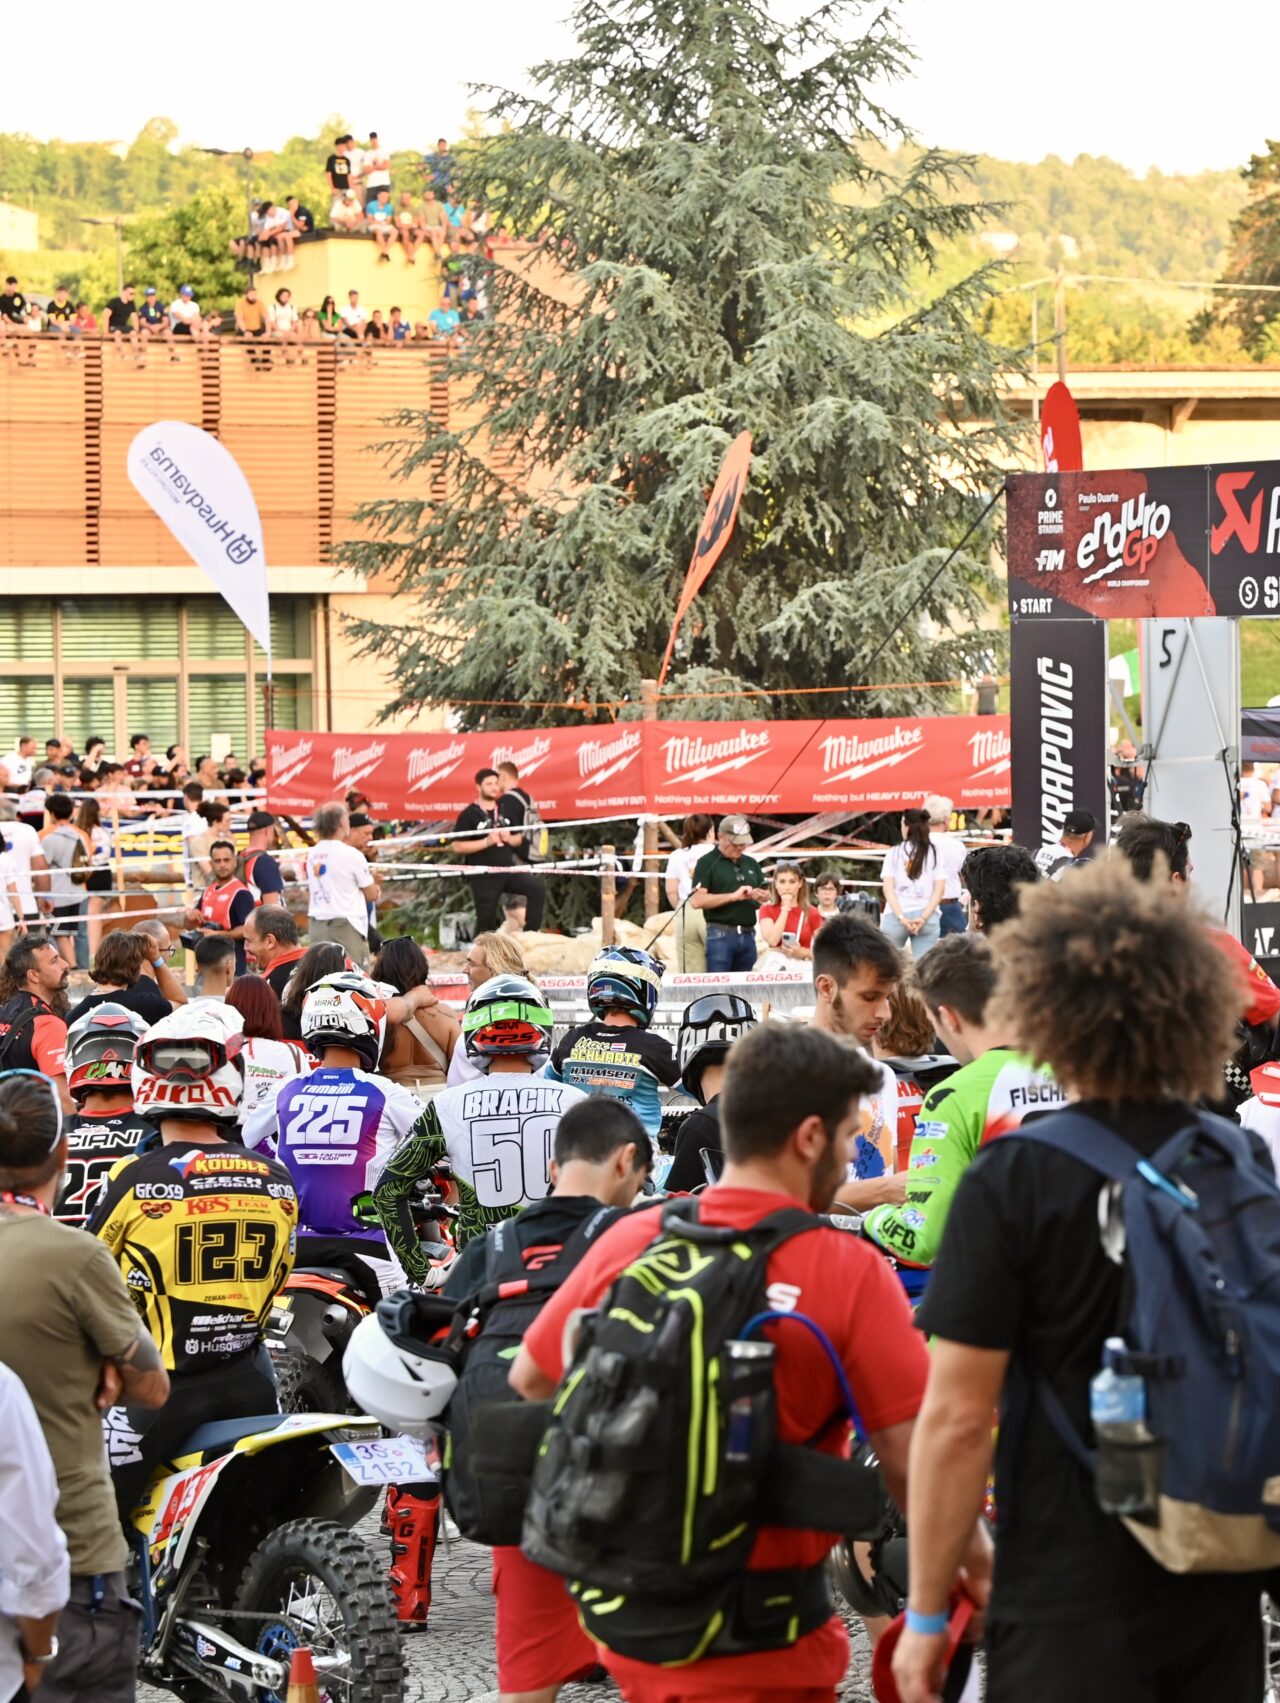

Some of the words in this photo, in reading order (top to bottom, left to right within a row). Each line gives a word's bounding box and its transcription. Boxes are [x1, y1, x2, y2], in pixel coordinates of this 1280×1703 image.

[1038, 511, 1063, 524] PRIME
[1020, 598, 1052, 613] START
[659, 728, 770, 773] Milwaukee
[818, 726, 924, 772] Milwaukee
[655, 795, 692, 806] Nothing
[693, 794, 709, 803] but
[813, 793, 848, 804] Nothing
[849, 793, 864, 802] but
[866, 792, 900, 801] HEAVY
[673, 974, 730, 985] GASGAS
[746, 973, 803, 983] GASGAS
[575, 1036, 611, 1050] Max
[570, 1048, 642, 1067] SCHWARTE
[570, 1067, 637, 1079] HARMSEN
[463, 1088, 563, 1120] BRACIK
[286, 1095, 368, 1145] 225
[189, 1177, 263, 1185] CZECH
[185, 1196, 231, 1217] KBS
[882, 1216, 917, 1250] UFO
[175, 1219, 278, 1286] 123
[359, 1461, 419, 1481] Z152
